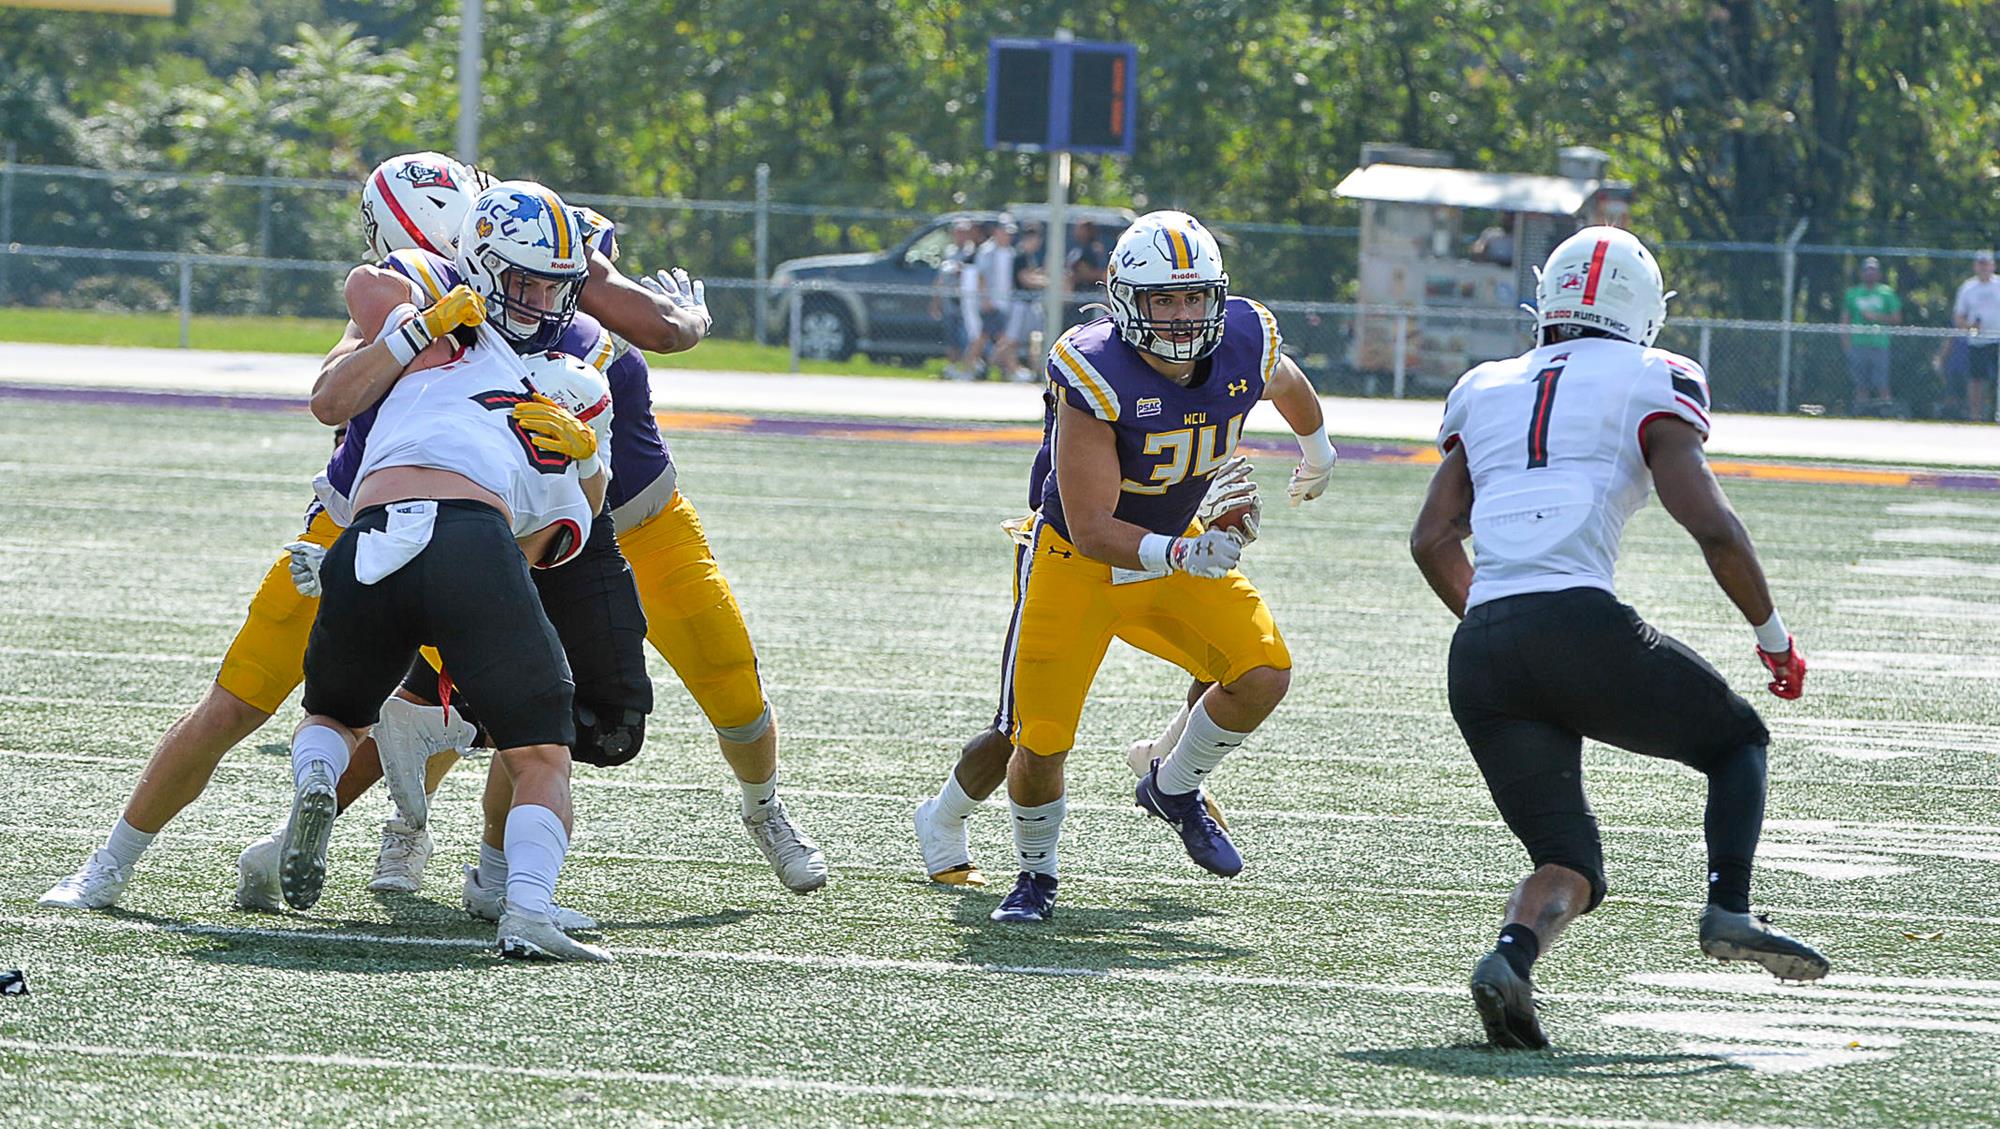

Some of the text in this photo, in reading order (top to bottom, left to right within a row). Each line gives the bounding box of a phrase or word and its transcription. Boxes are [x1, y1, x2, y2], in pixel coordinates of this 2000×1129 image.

[1573, 311, 1602, 323] RUNS
[1137, 402, 1160, 412] PSAC
[1184, 412, 1207, 426] WCU
[1527, 365, 1566, 470] 1
[1120, 413, 1243, 496] 34
